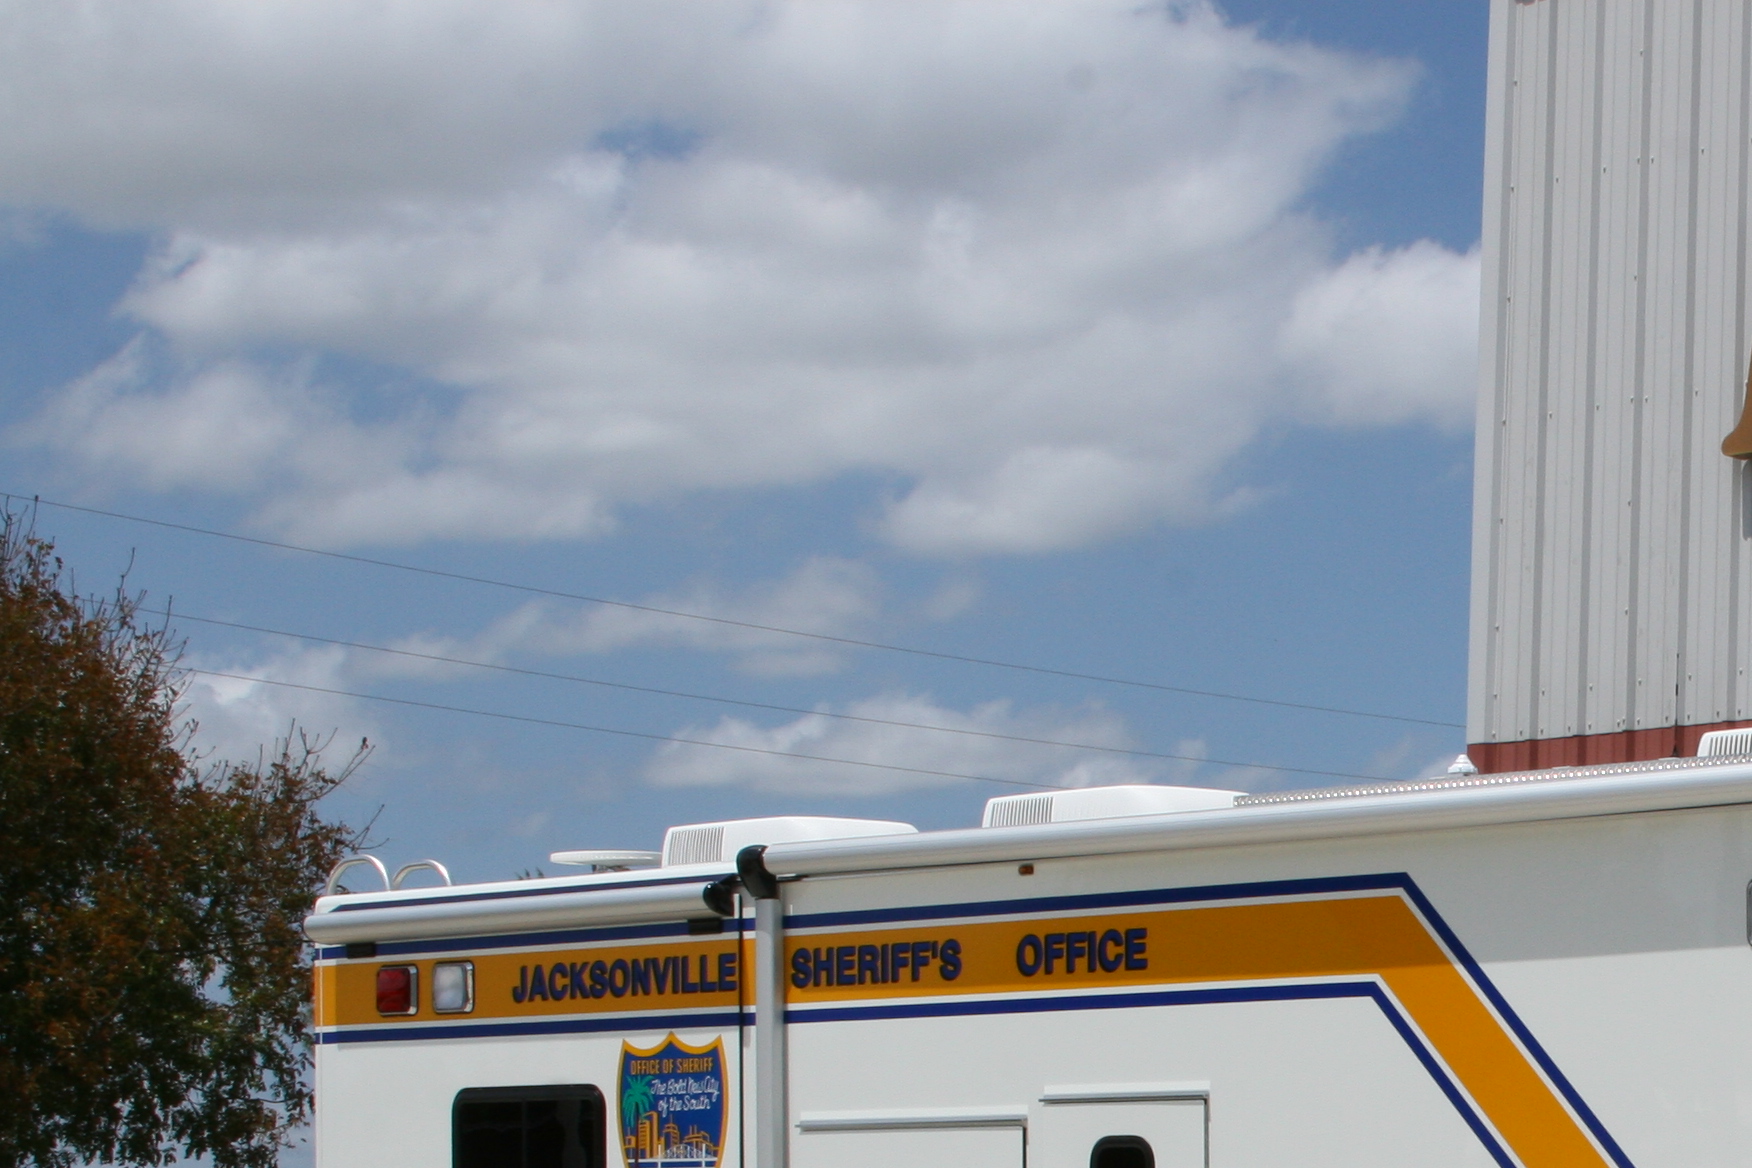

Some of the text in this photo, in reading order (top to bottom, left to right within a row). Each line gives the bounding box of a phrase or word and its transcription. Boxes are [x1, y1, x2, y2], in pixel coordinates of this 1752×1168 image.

[512, 928, 1148, 1003] JACKSONVILLE SHERIFF'S OFFICE
[630, 1057, 714, 1075] OFFICE OF SHERIFF
[650, 1078, 667, 1095] The
[667, 1076, 688, 1096] Bold
[703, 1075, 720, 1101] City
[658, 1095, 711, 1118] of the South
